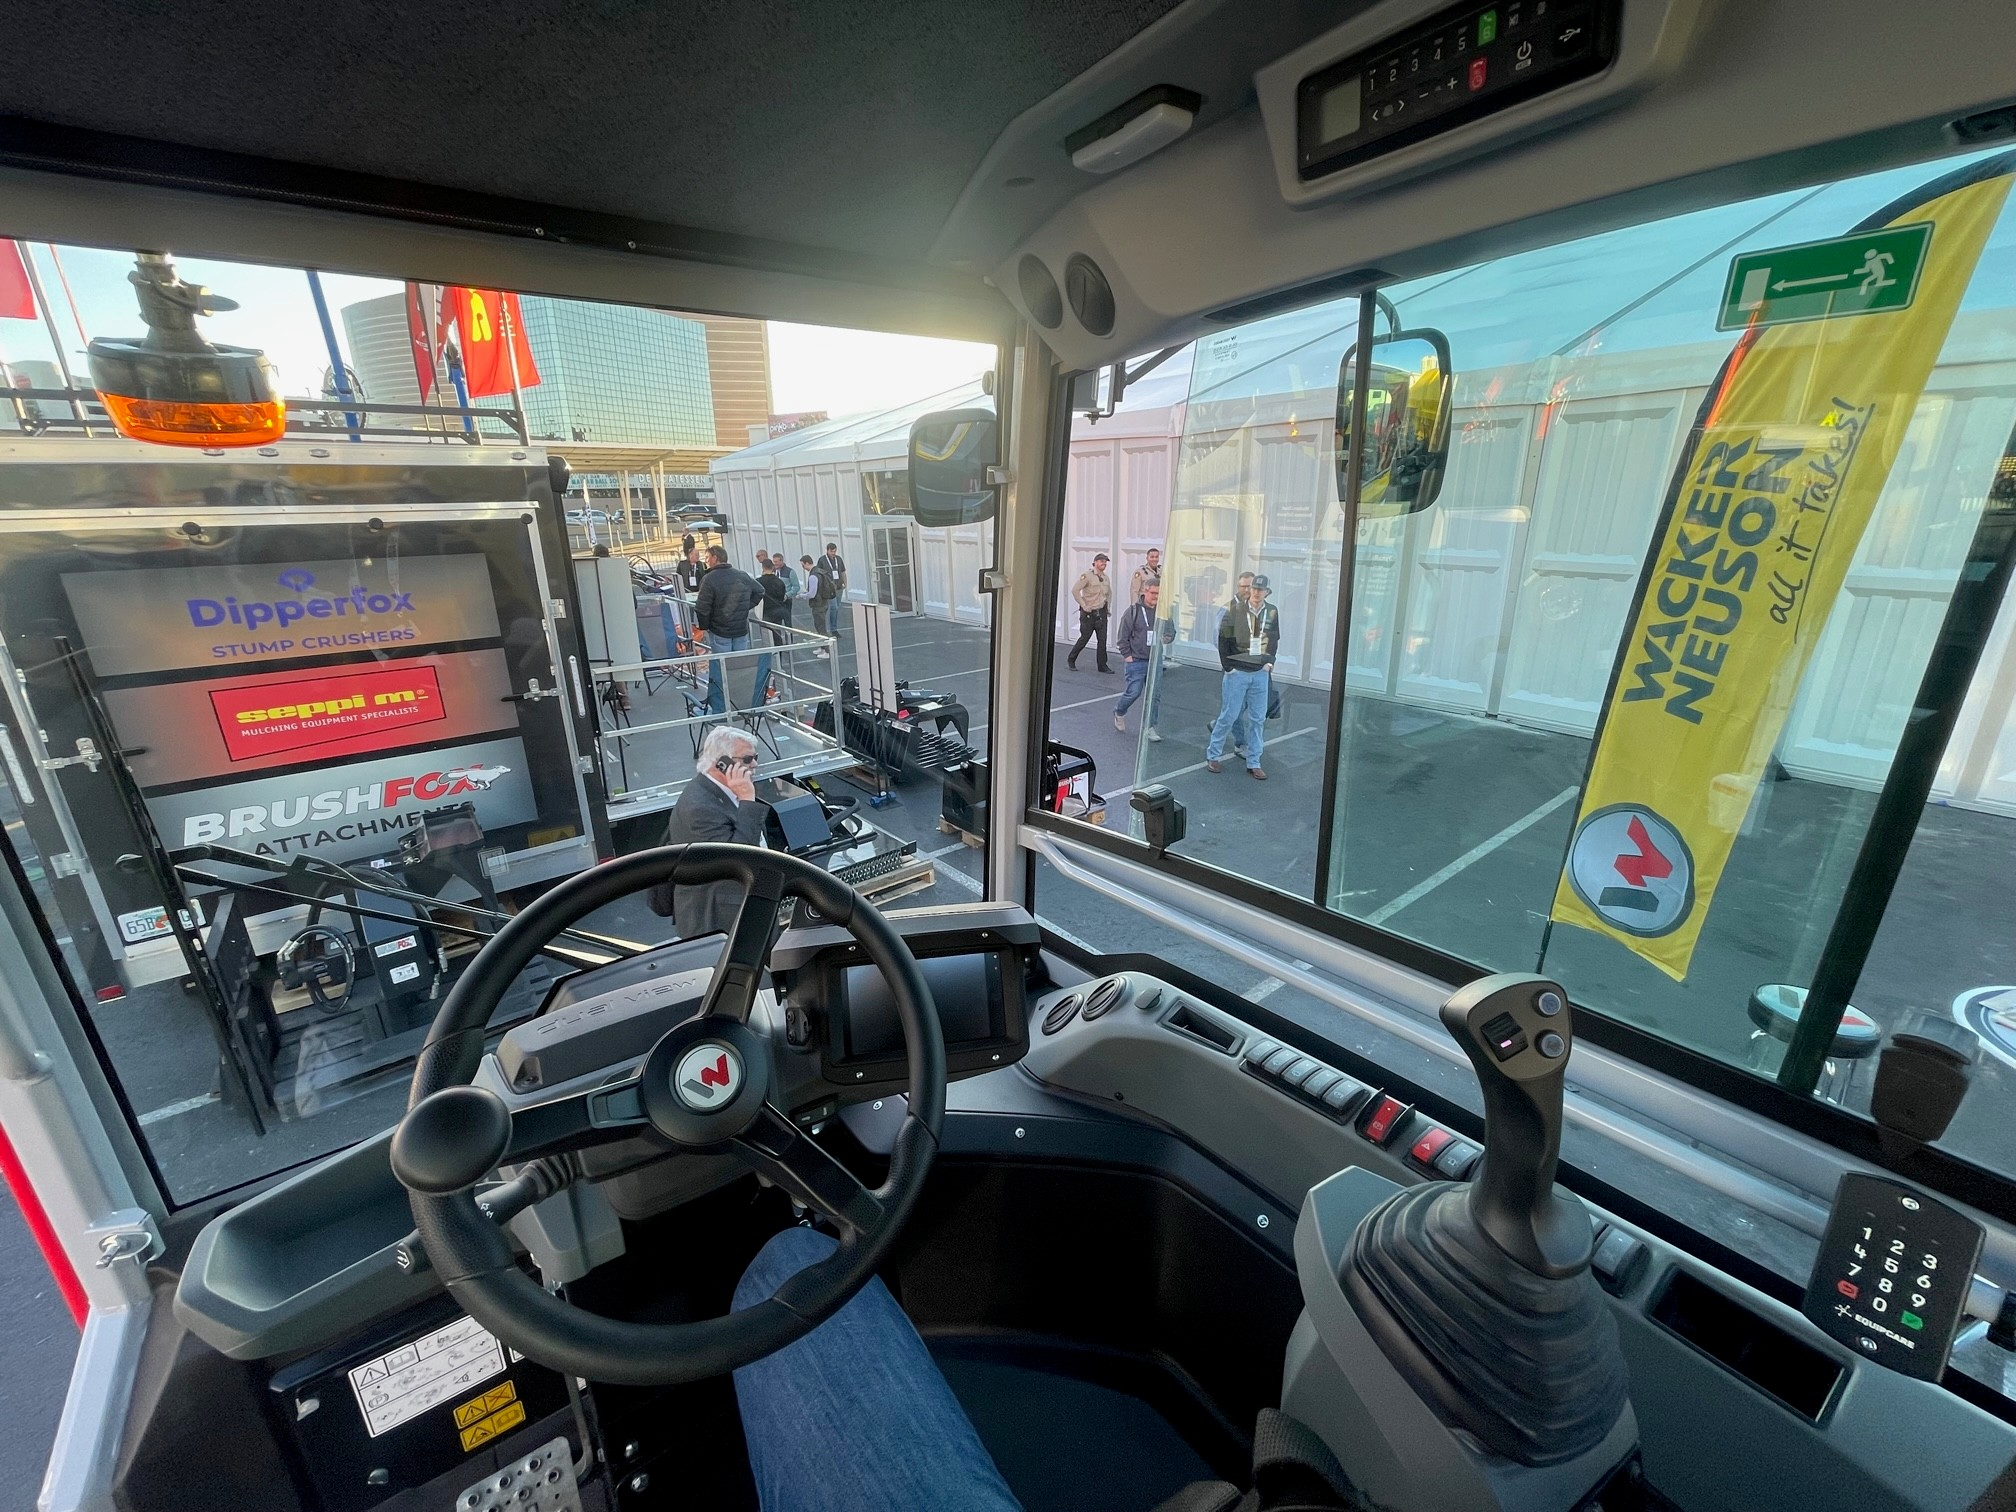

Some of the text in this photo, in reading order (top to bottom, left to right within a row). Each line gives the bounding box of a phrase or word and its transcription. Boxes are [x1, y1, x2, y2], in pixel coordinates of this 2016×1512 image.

[1369, 78, 1375, 91] 1
[1389, 69, 1397, 82] 2
[1411, 59, 1419, 72] 3
[1433, 48, 1442, 61] 4
[1458, 36, 1466, 51] 5
[1776, 520, 1812, 562] it
[1621, 437, 1755, 703] WACKER
[1664, 440, 1807, 726] NEUSON
[187, 587, 416, 631] Dipperfox
[1769, 571, 1803, 625] all
[212, 628, 415, 658] STUMP CRUSHERS
[236, 694, 366, 724] seppi
[241, 706, 419, 737] MULCHING EQUIPMENT SPECIALISTS
[183, 763, 484, 847] BRUSHFOX
[537, 978, 697, 1036] dual view
[1853, 1243, 1932, 1289] 4 5 6
[1862, 1226, 1938, 1270] 1 2 3
[1847, 1262, 1926, 1308] 7 8 9
[1872, 1296, 1888, 1313] 0
[1854, 1313, 1916, 1350] EQUIPCARE
